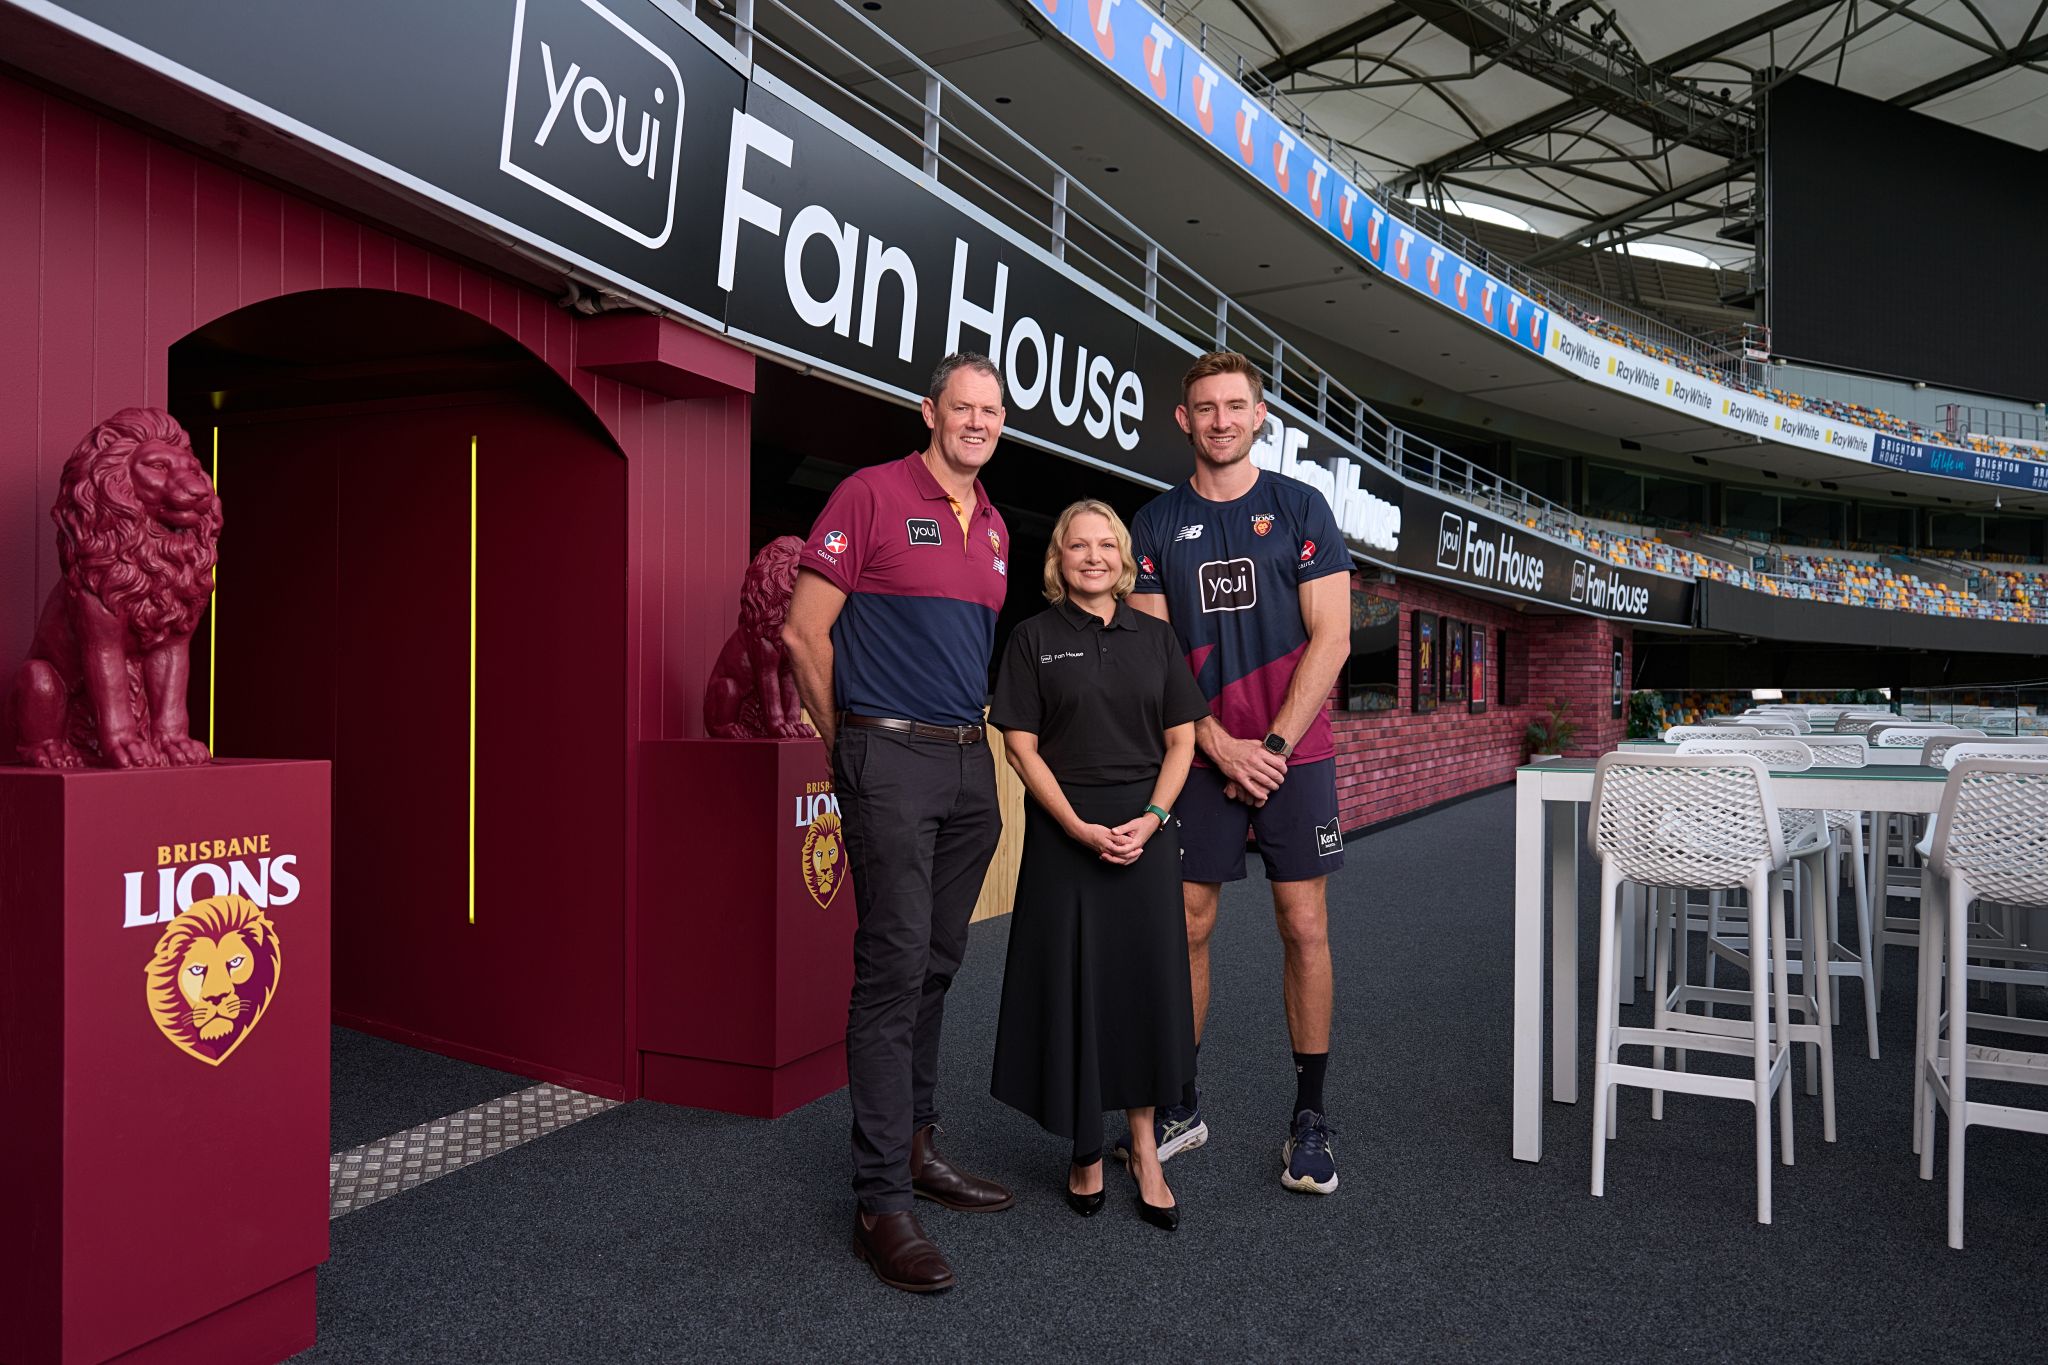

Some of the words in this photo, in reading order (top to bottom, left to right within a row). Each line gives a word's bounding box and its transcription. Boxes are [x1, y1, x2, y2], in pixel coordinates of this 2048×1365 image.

[534, 40, 664, 181] youi
[717, 107, 918, 363] Fan
[945, 236, 1145, 452] House
[1881, 439, 1923, 458] BRIGHTON
[1879, 451, 1904, 466] HOMES
[1975, 457, 2020, 473] BRIGHTON
[1974, 468, 2000, 481] HOMES
[912, 524, 937, 540] youi
[817, 549, 838, 565] CALTEX
[1441, 526, 1460, 556] youi
[1463, 520, 1495, 579] Fan
[1497, 533, 1544, 592] House
[1208, 566, 1247, 602] youi
[1586, 564, 1606, 608] Fan
[1606, 571, 1649, 615] House
[1320, 830, 1338, 845] Keri
[157, 834, 270, 865] BRISBANE
[123, 854, 300, 928] LIONS
